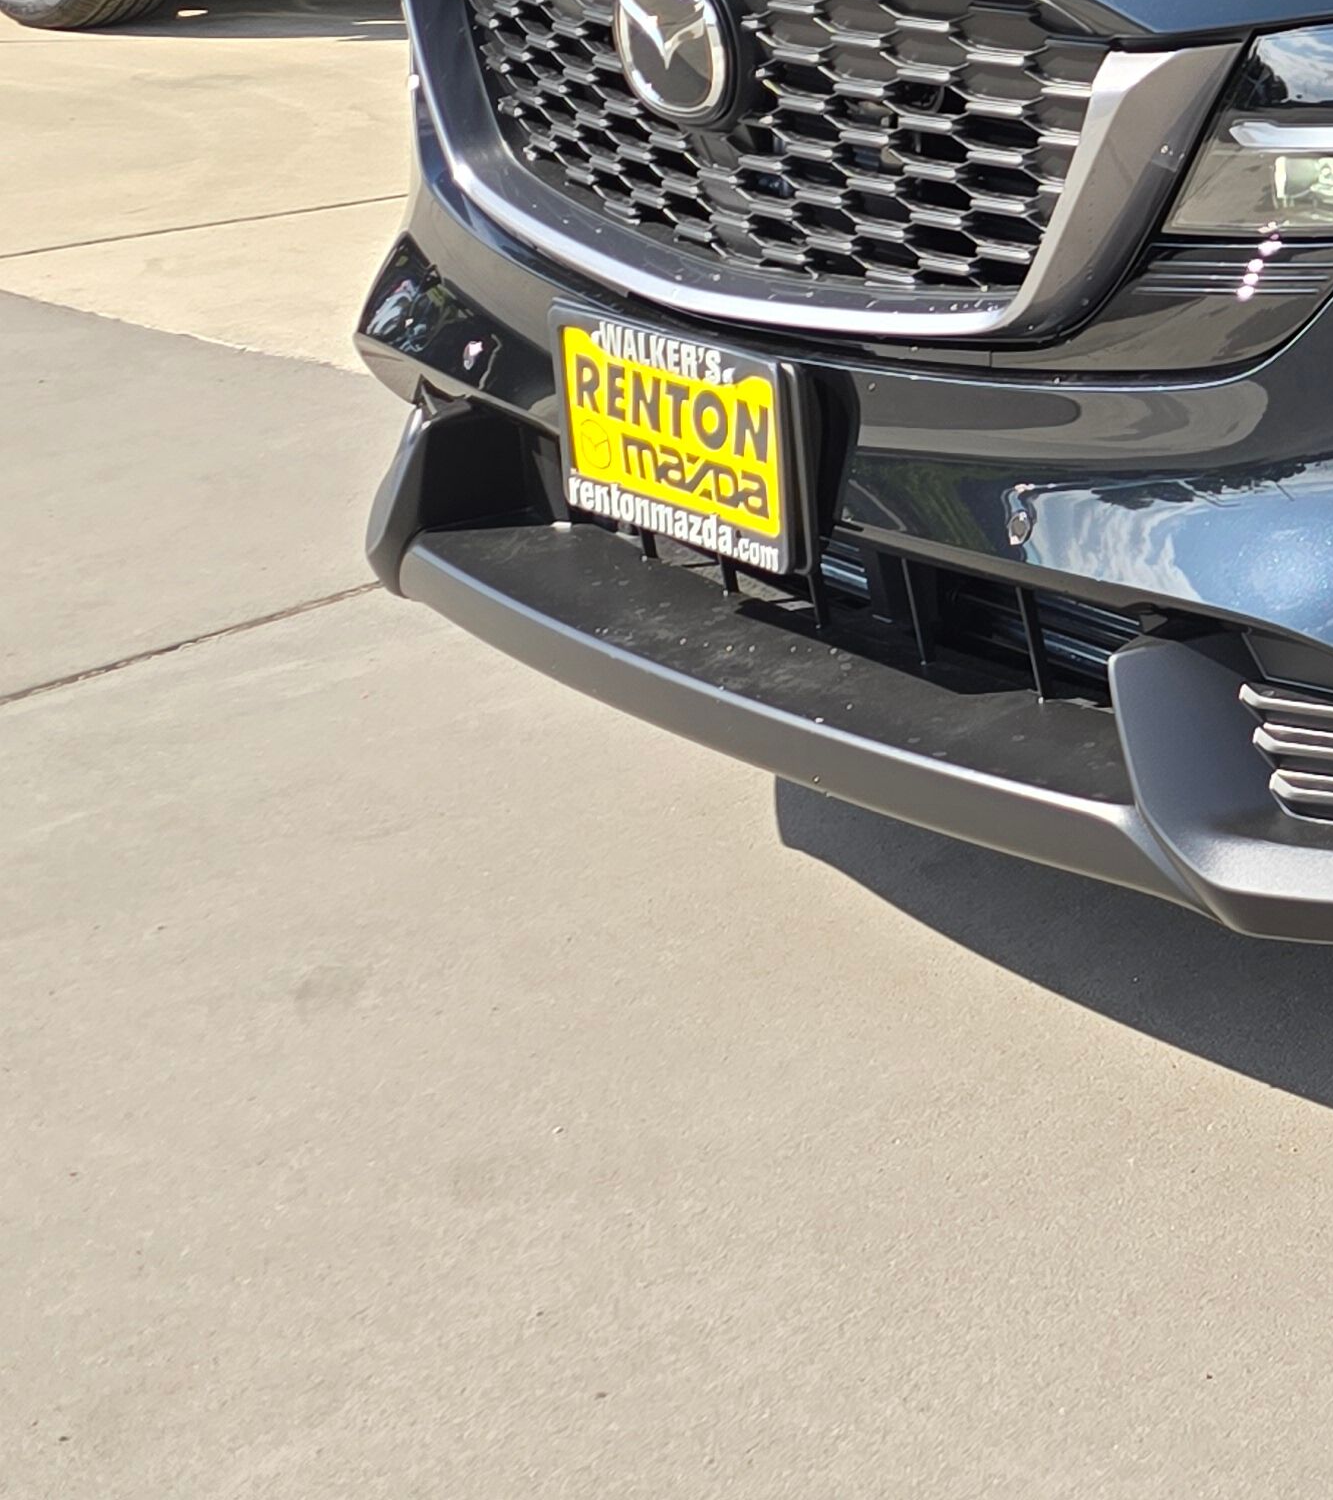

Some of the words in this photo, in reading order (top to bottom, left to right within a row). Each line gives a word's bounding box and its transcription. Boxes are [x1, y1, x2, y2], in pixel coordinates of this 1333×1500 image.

[598, 321, 723, 385] WALKER'S
[575, 353, 769, 464] RENTON
[568, 476, 780, 573] rentonmazda.com
